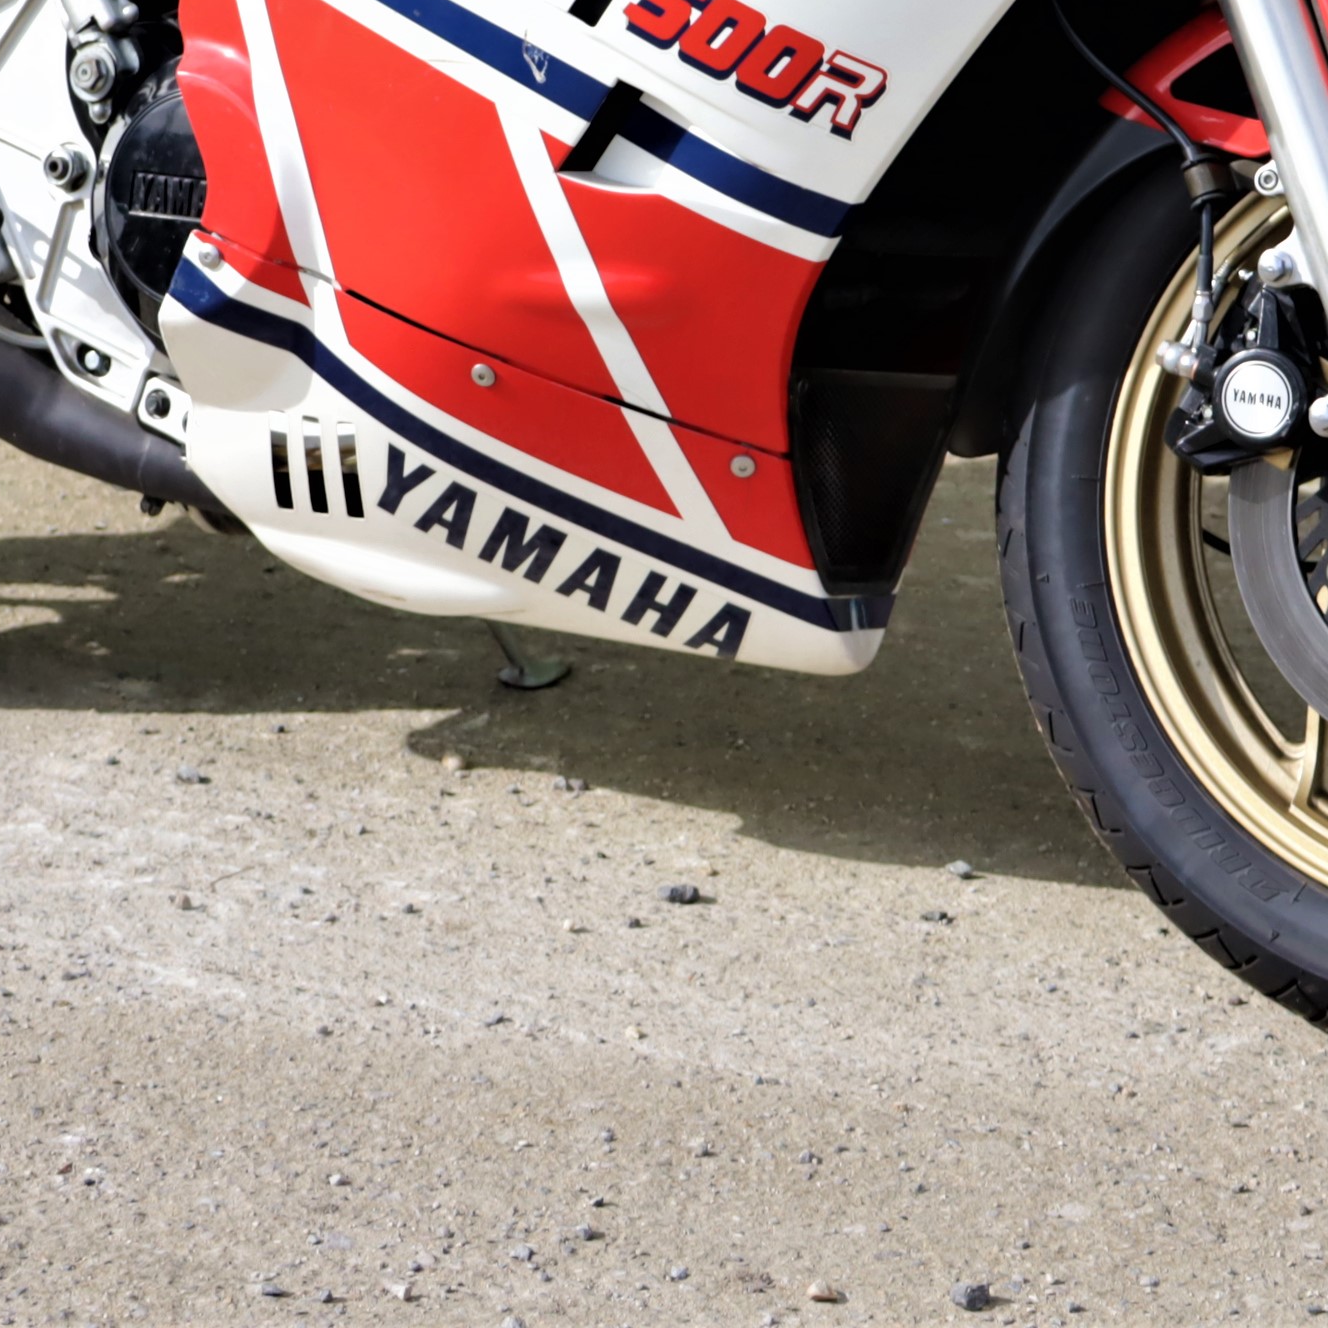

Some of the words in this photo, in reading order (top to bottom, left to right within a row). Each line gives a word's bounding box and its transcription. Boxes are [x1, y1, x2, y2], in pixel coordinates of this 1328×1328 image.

[132, 171, 207, 218] YAMA
[1233, 387, 1282, 410] YAMAHA
[377, 442, 753, 661] YAMAHA
[1068, 597, 1290, 902] BRIDGESTONE
